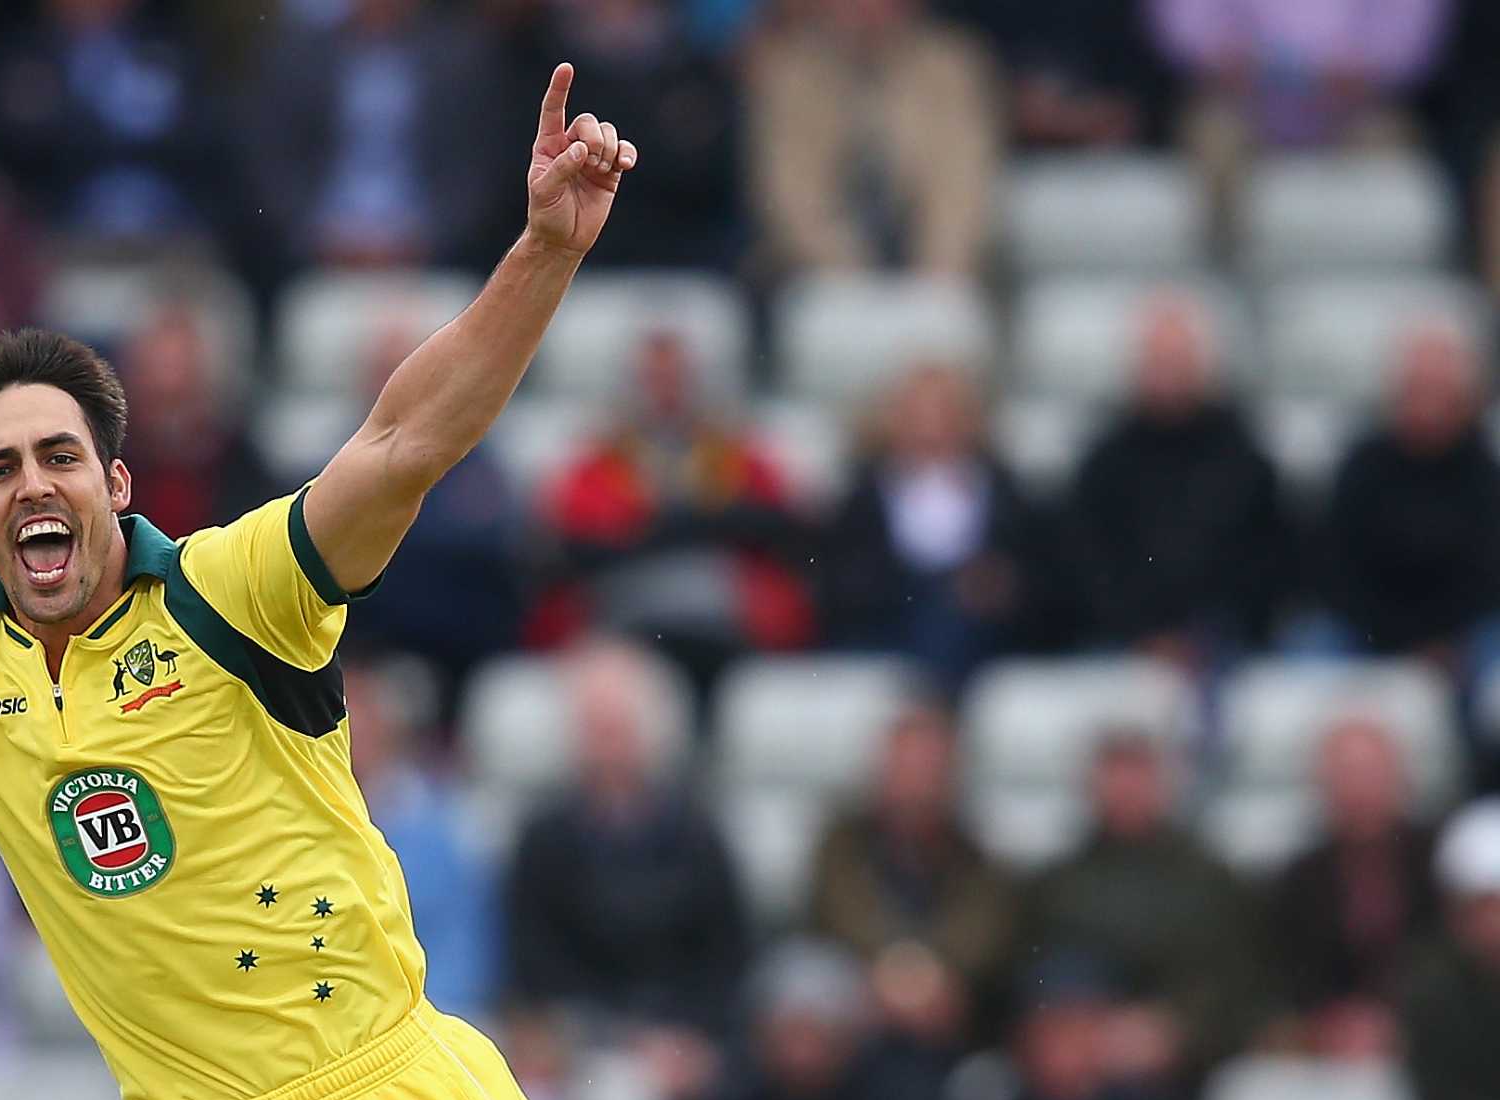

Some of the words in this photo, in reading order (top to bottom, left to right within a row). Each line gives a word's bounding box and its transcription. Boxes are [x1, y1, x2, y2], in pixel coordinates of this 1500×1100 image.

[53, 772, 139, 813] VICTORIA
[78, 808, 141, 851] VB
[88, 853, 167, 891] BITTER
